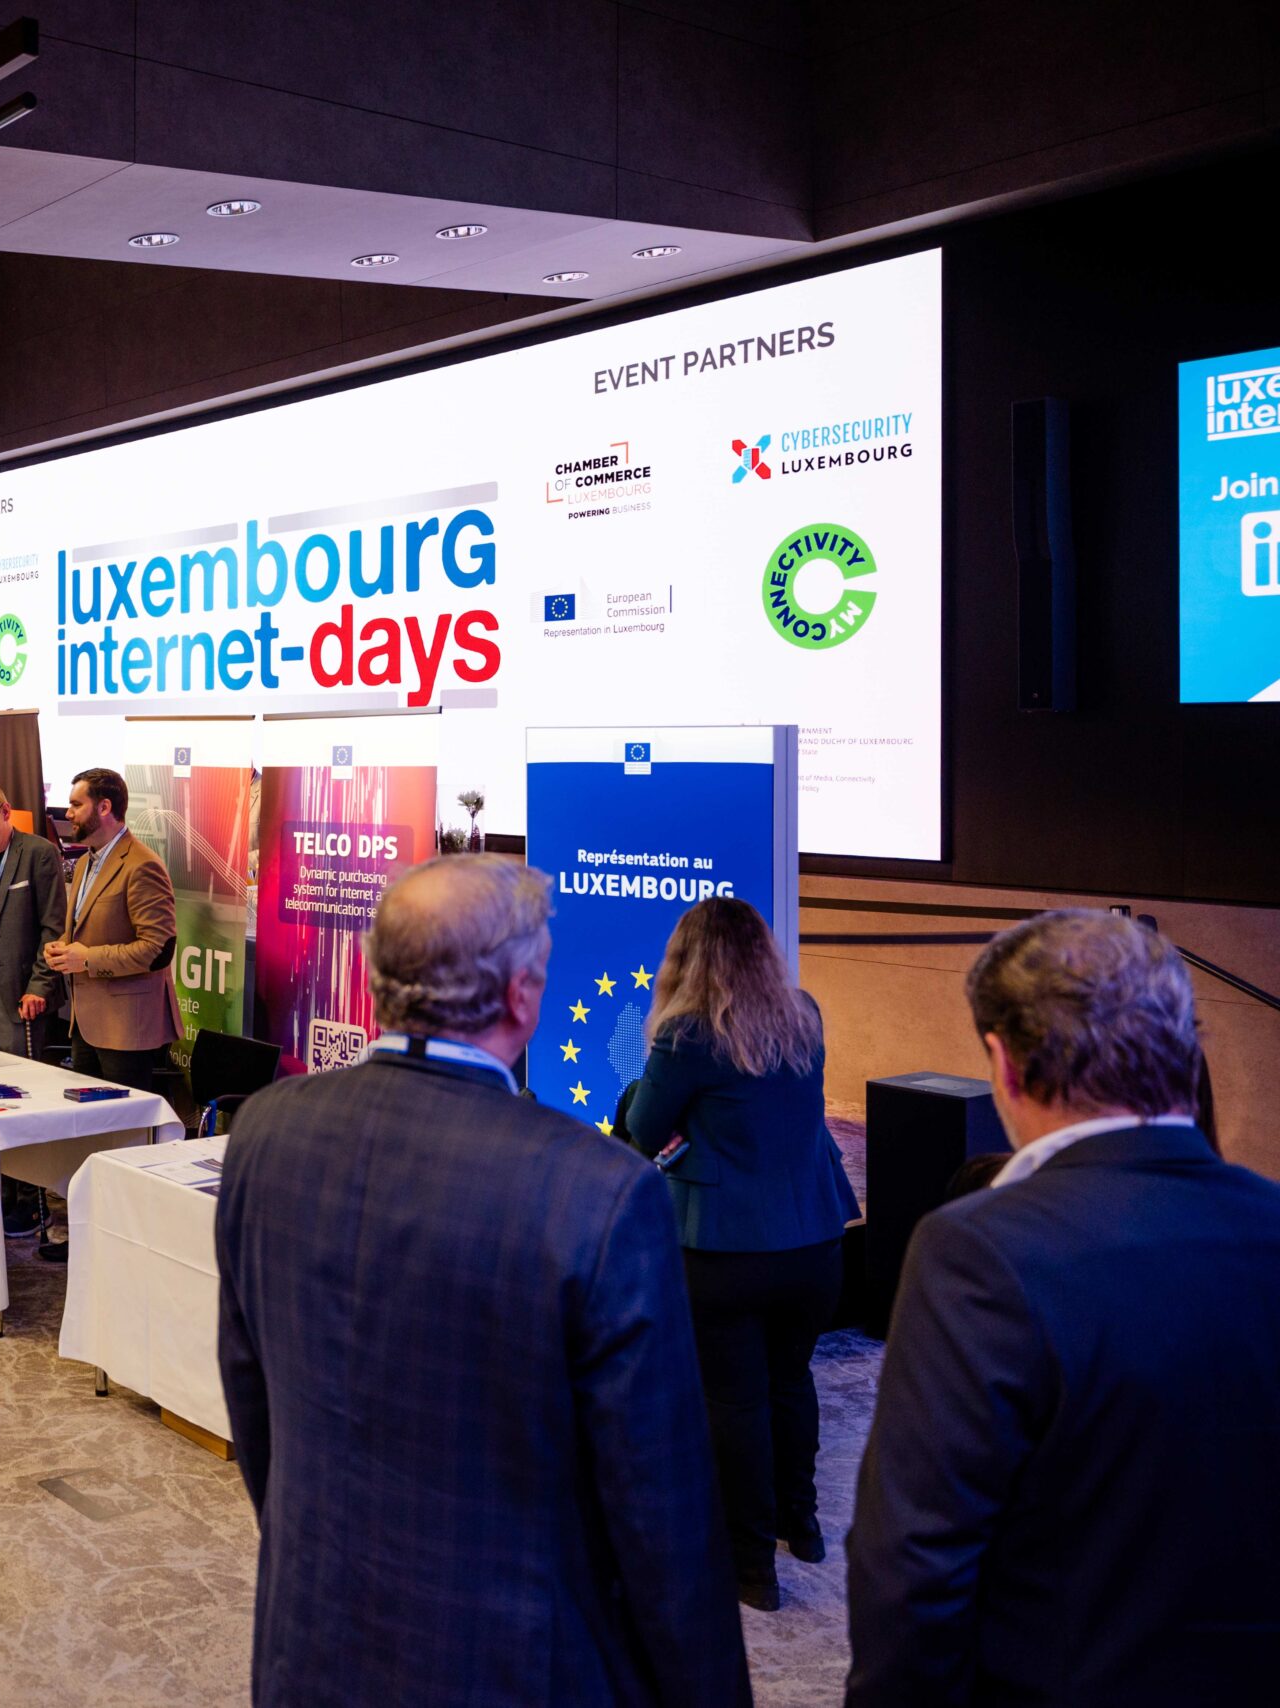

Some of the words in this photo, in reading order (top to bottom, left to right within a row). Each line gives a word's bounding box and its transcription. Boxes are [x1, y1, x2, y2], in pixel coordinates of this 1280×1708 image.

[593, 354, 676, 395] EVENT
[683, 321, 836, 376] PARTNERS
[1206, 400, 1280, 435] inte
[780, 412, 913, 453] CYBERSECURITY
[555, 455, 619, 475] CHAMBER
[780, 443, 914, 475] LUXEMBOURG
[554, 478, 572, 492] OF
[575, 466, 652, 488] COMMERCE
[1211, 472, 1279, 502] Join
[567, 482, 652, 505] LUXEMBOURG
[568, 507, 611, 520] POWERING
[611, 501, 652, 515] BUSINESS
[606, 591, 652, 605] European
[768, 531, 866, 642] CONNECTIVITY
[606, 605, 666, 618] Commission
[543, 625, 602, 639] Representation
[603, 624, 611, 634] in
[613, 621, 665, 635] Luxembourg
[58, 604, 501, 707] internet-days
[293, 831, 352, 857] TELCO
[358, 834, 398, 860] DPS
[577, 848, 689, 870] Représentation
[693, 854, 713, 870] au
[300, 865, 337, 882] Dynamic
[338, 869, 387, 888] purchasing
[559, 871, 734, 901] LUXEMBOURG
[293, 883, 323, 897] system
[325, 883, 338, 898] for
[340, 885, 374, 901] internet
[285, 897, 365, 918] telecommunication
